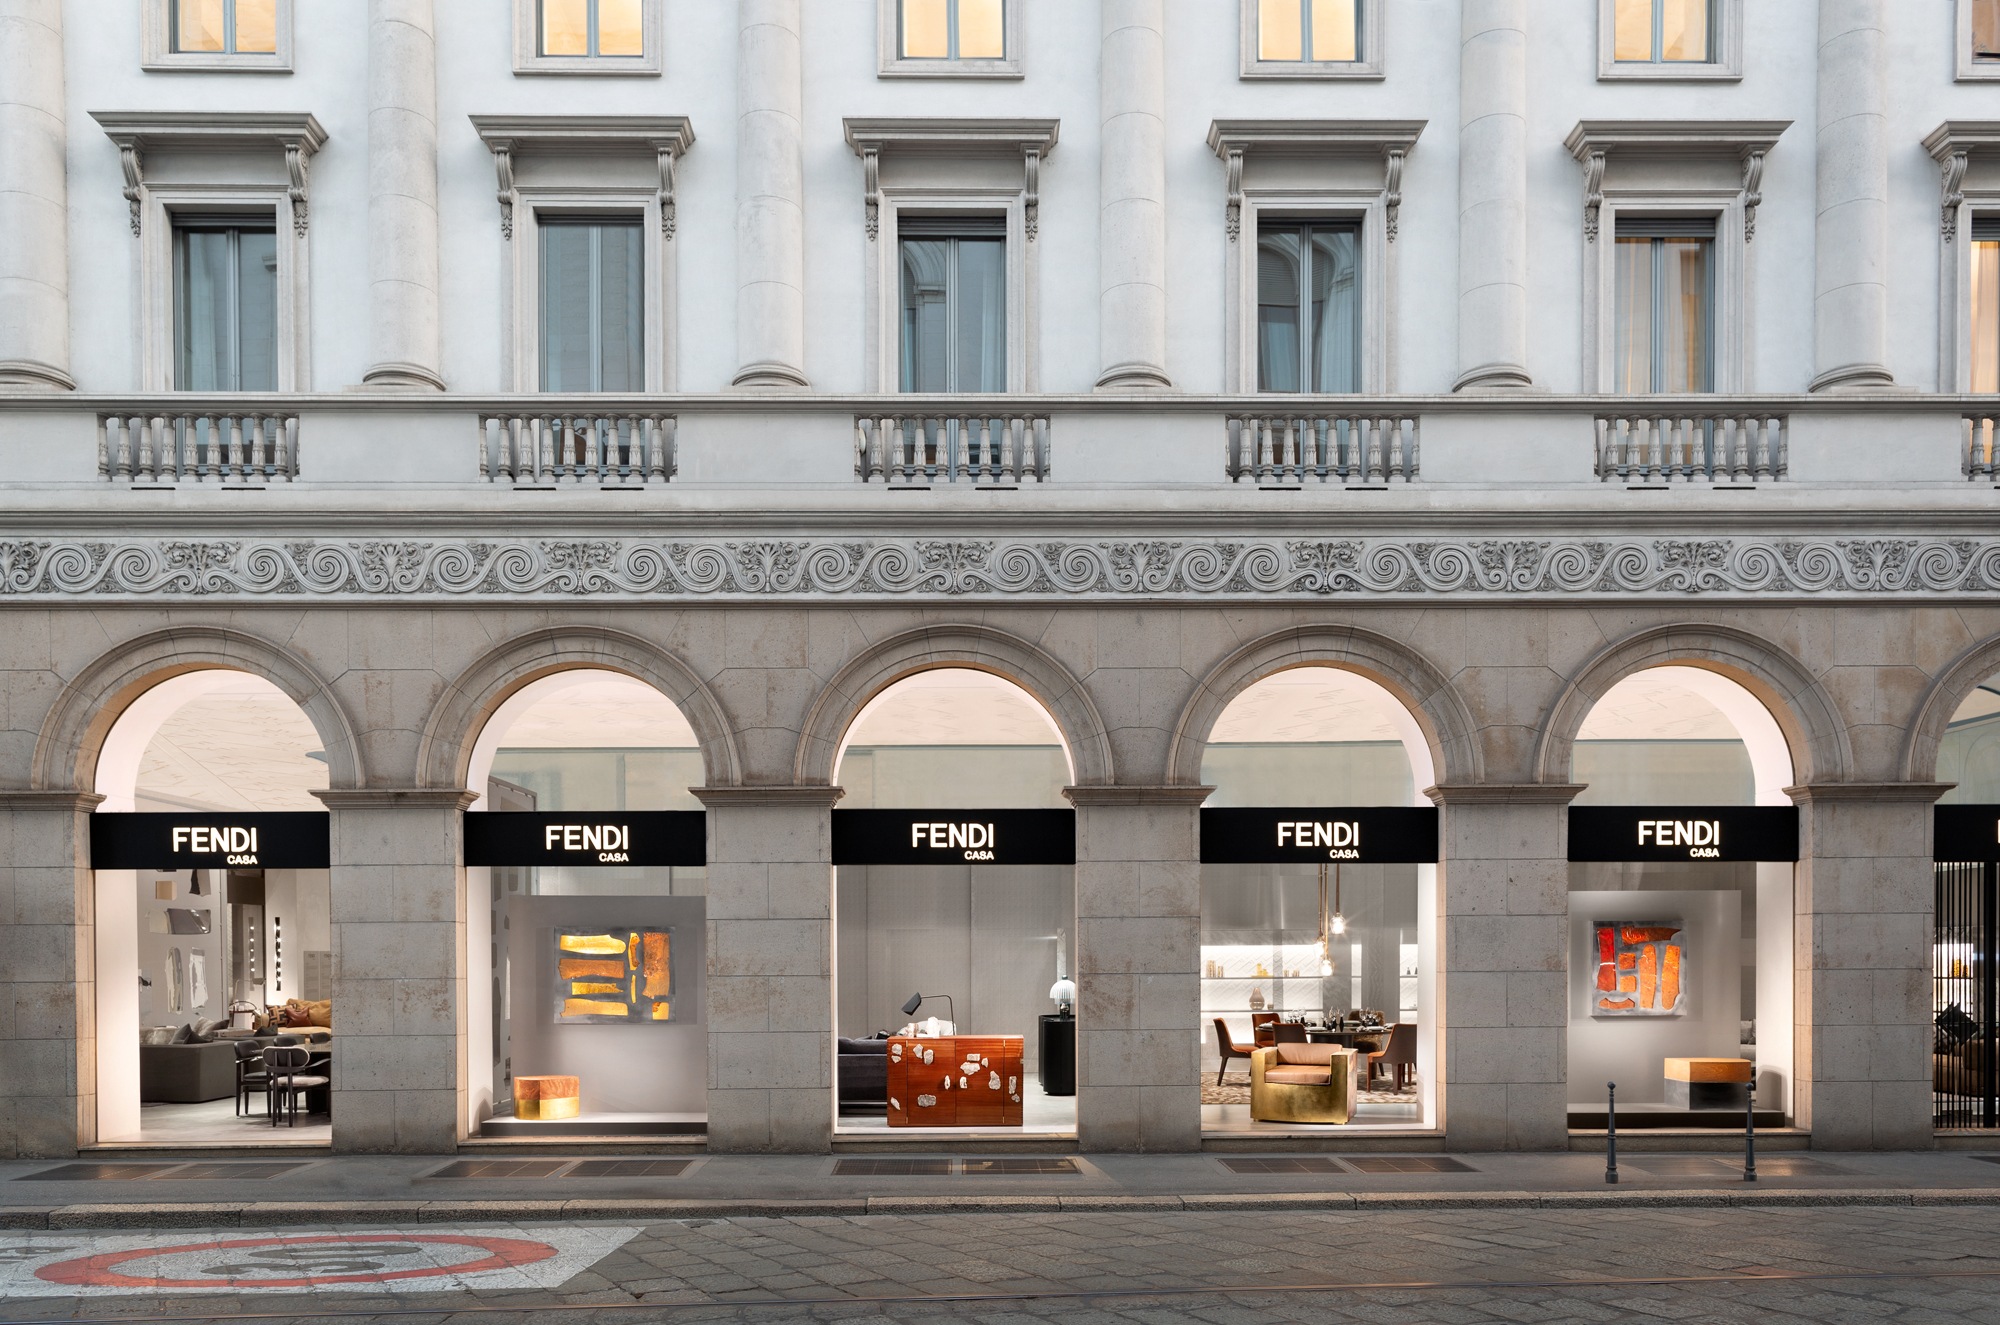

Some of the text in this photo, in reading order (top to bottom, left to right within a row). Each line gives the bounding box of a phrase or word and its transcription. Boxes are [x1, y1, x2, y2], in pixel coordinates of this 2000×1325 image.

[173, 827, 257, 852] FENDI
[546, 826, 629, 850] FENDI
[912, 823, 994, 847] FENDI
[1277, 822, 1359, 846] FENDI
[1638, 821, 1719, 845] FENDI
[227, 854, 258, 864] CASA
[598, 852, 629, 862] CASA
[964, 850, 994, 860] CASA
[1329, 848, 1359, 858] CASA
[1689, 847, 1719, 857] CASA
[200, 1246, 423, 1275] 30
